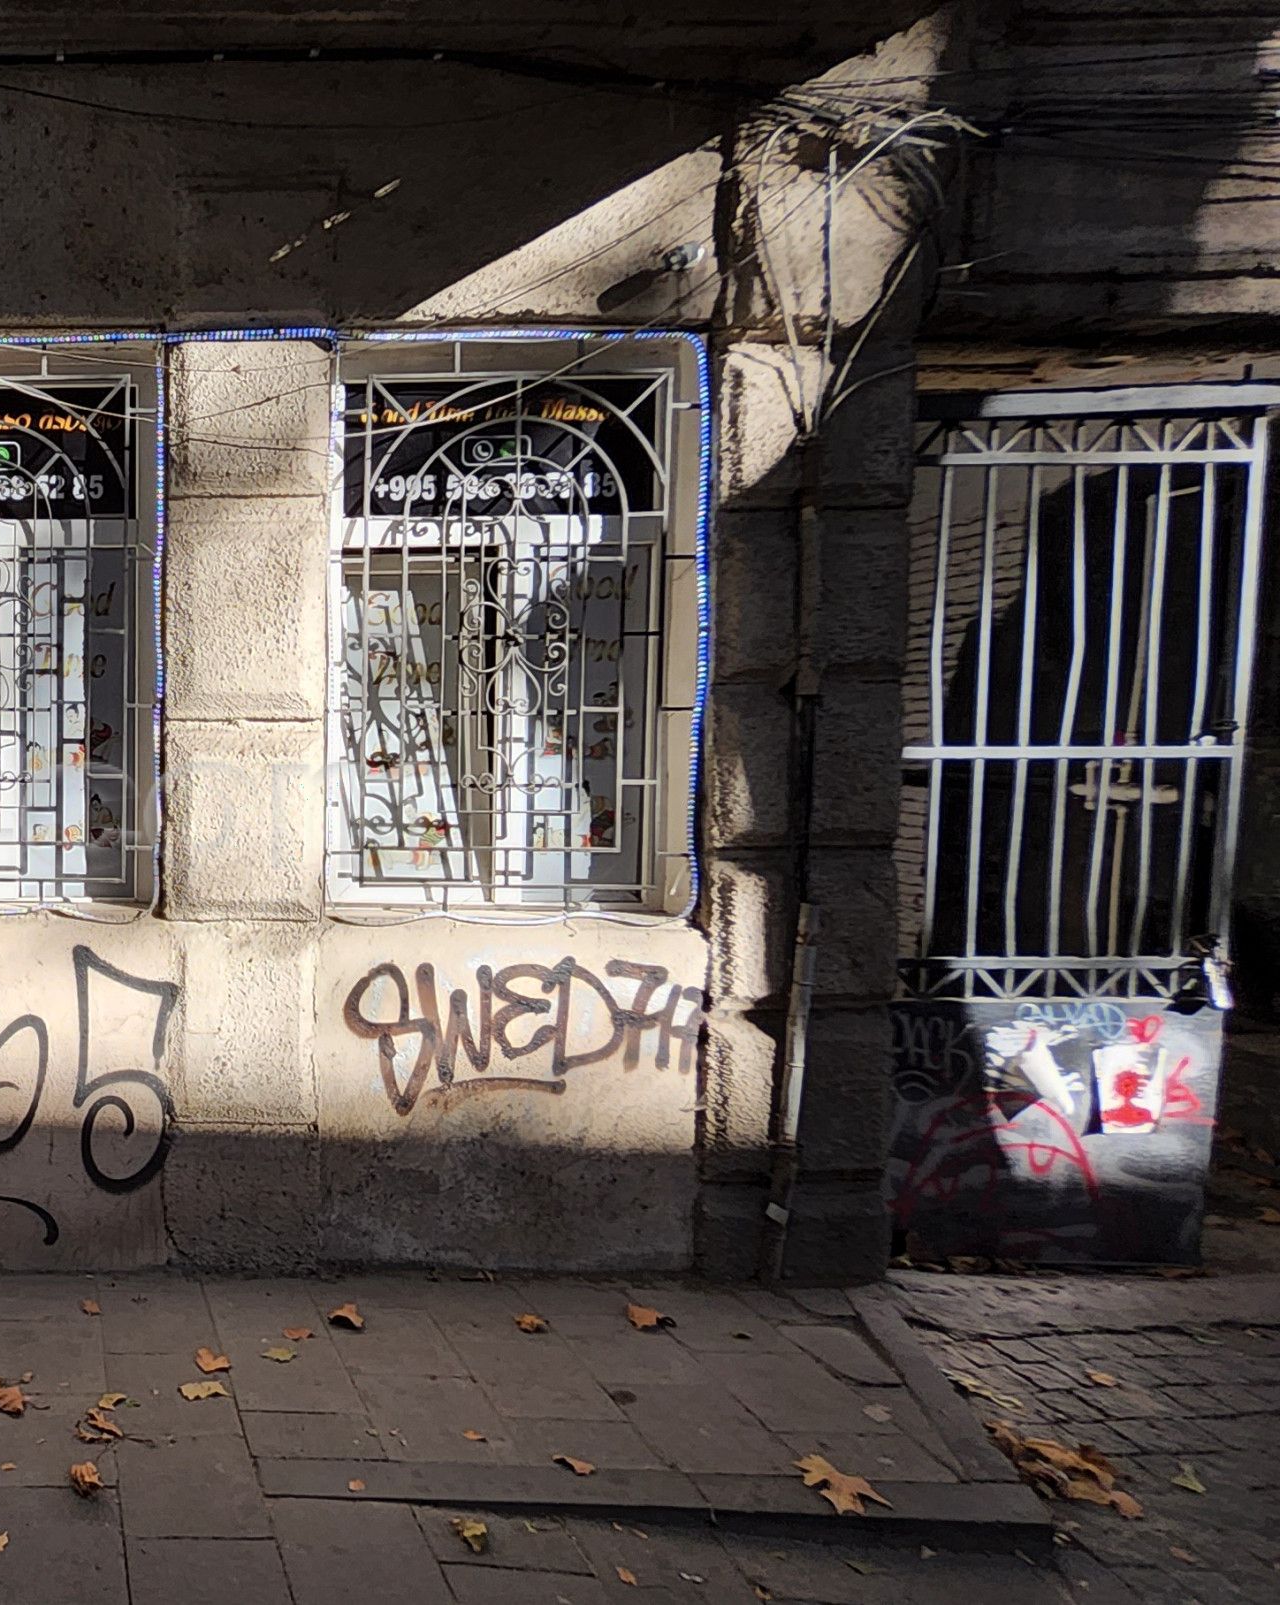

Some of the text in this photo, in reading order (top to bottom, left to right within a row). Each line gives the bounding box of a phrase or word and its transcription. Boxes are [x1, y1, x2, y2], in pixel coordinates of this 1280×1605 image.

[72, 473, 104, 500] 85
[374, 474, 438, 502] +995
[583, 472, 617, 499] 85
